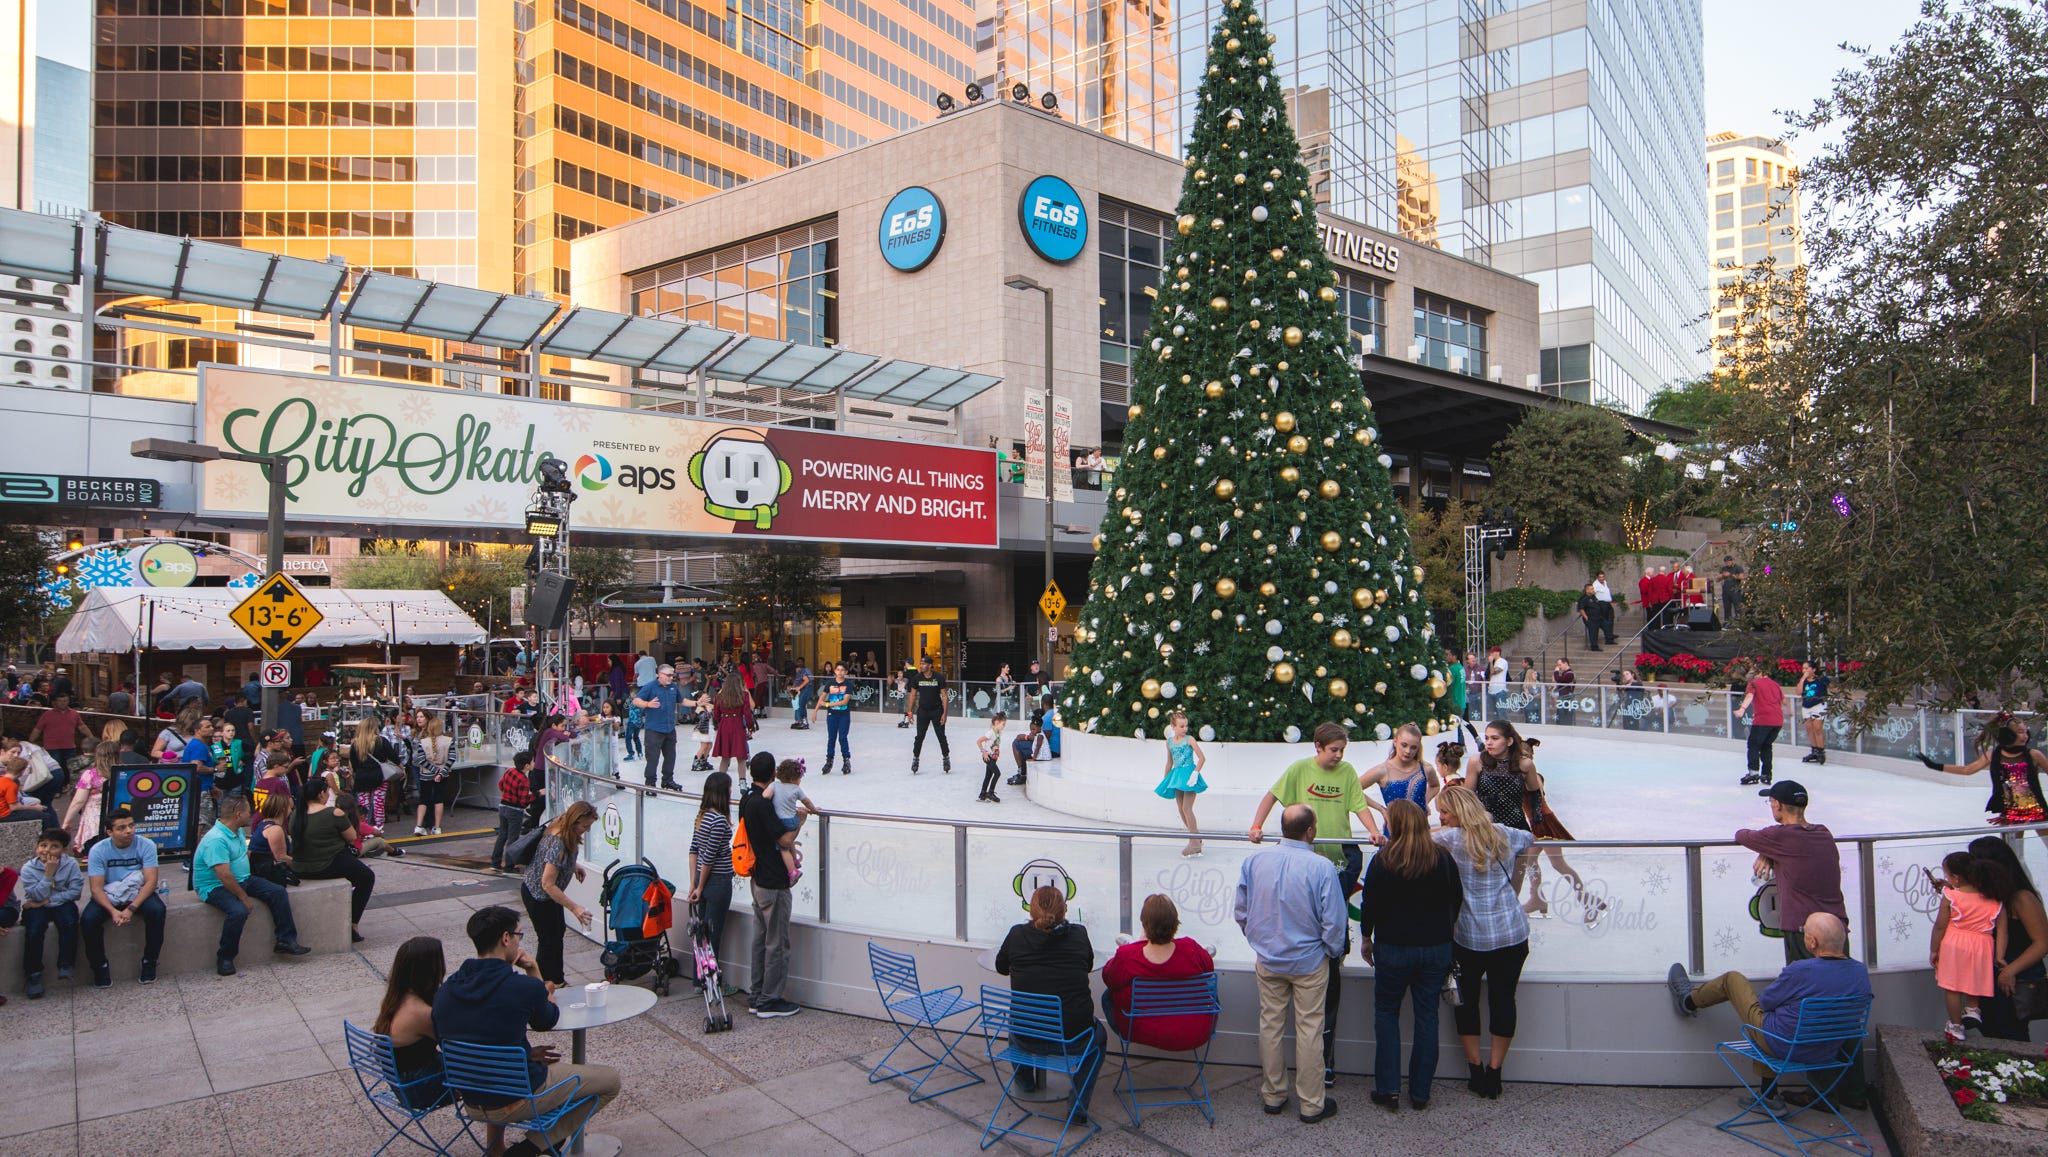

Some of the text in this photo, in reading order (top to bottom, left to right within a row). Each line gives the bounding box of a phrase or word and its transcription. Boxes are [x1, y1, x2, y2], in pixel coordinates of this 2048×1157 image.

[887, 228, 931, 250] FITNESS
[1031, 218, 1078, 240] FITNESS
[1316, 222, 1400, 273] FITNESS
[222, 397, 397, 503] City
[593, 440, 660, 453] PRESENTED BY
[617, 464, 676, 494] aps
[802, 458, 984, 491] POWERING ALL THINGS
[67, 480, 135, 492] BECKER
[67, 491, 135, 503] BOARDS
[802, 488, 987, 520] MERRY AND BRIGHT.
[163, 561, 193, 575] aps
